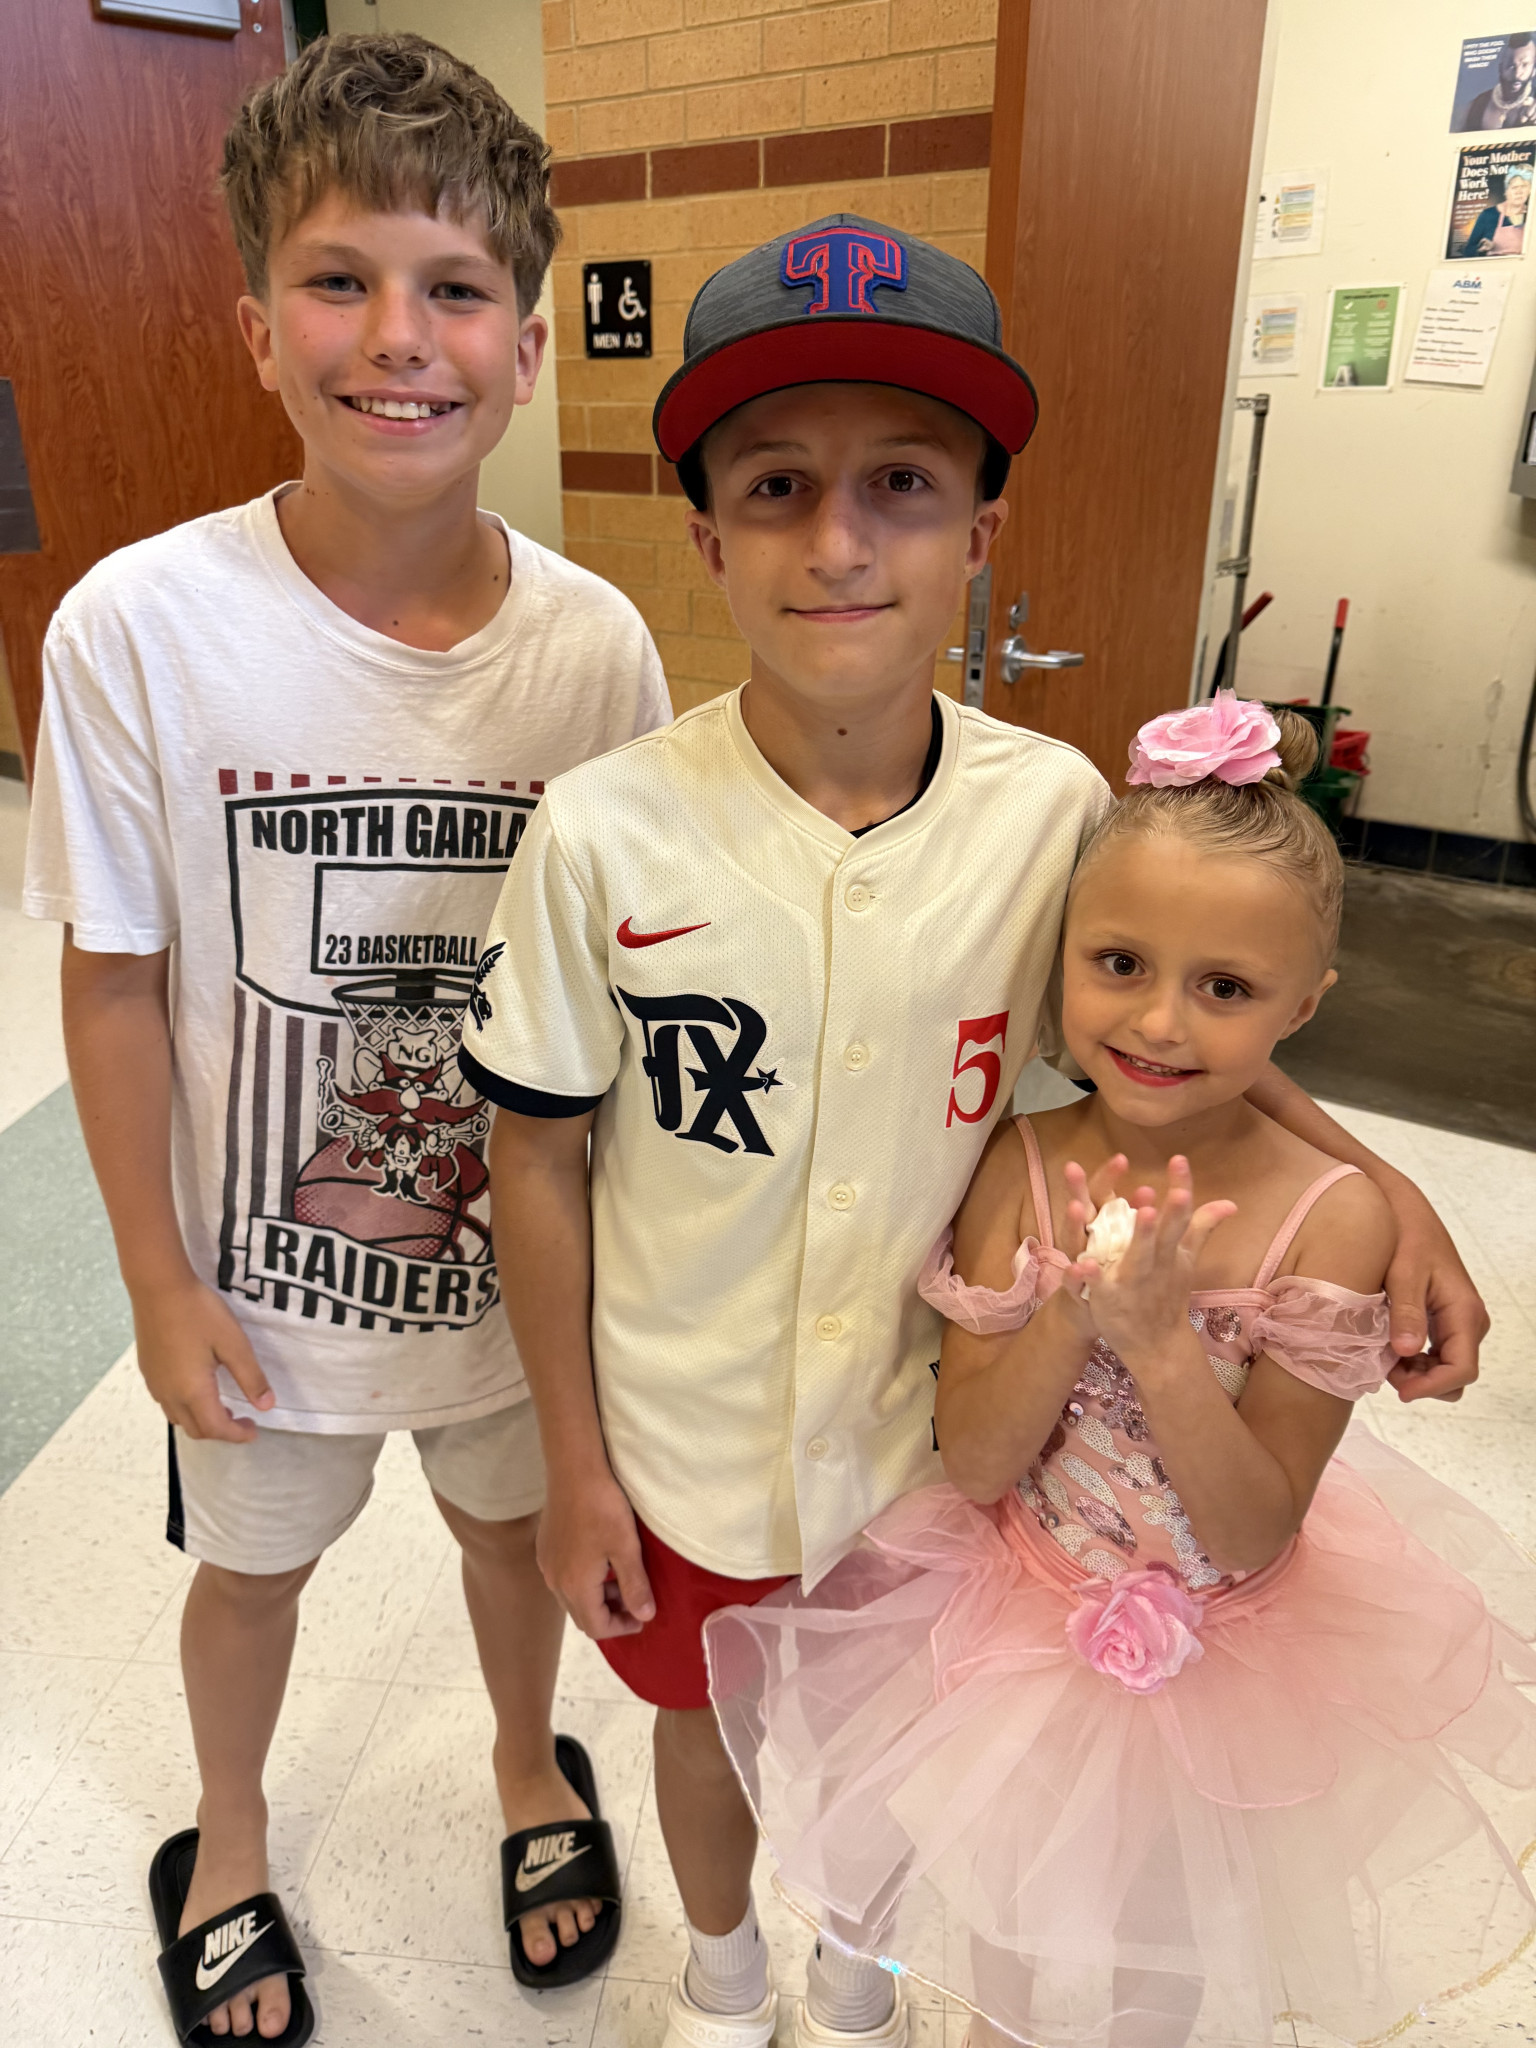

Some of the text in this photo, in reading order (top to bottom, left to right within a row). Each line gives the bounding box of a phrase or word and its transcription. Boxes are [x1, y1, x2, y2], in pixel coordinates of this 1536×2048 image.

[1463, 150, 1532, 166] Your Mother
[1461, 164, 1509, 178] Does Not
[1460, 176, 1489, 190] Work
[1457, 188, 1490, 201] Here!
[1452, 279, 1482, 289] ABM
[592, 331, 643, 349] MEN A3
[251, 805, 394, 858] NORTH
[324, 934, 478, 967] 23 BASKETBALL
[397, 1043, 432, 1063] NG
[945, 1009, 1010, 1129] 5
[263, 1223, 499, 1317] RAIDERS
[525, 1830, 577, 1869] NIKE
[203, 1910, 258, 1965] NIKE
